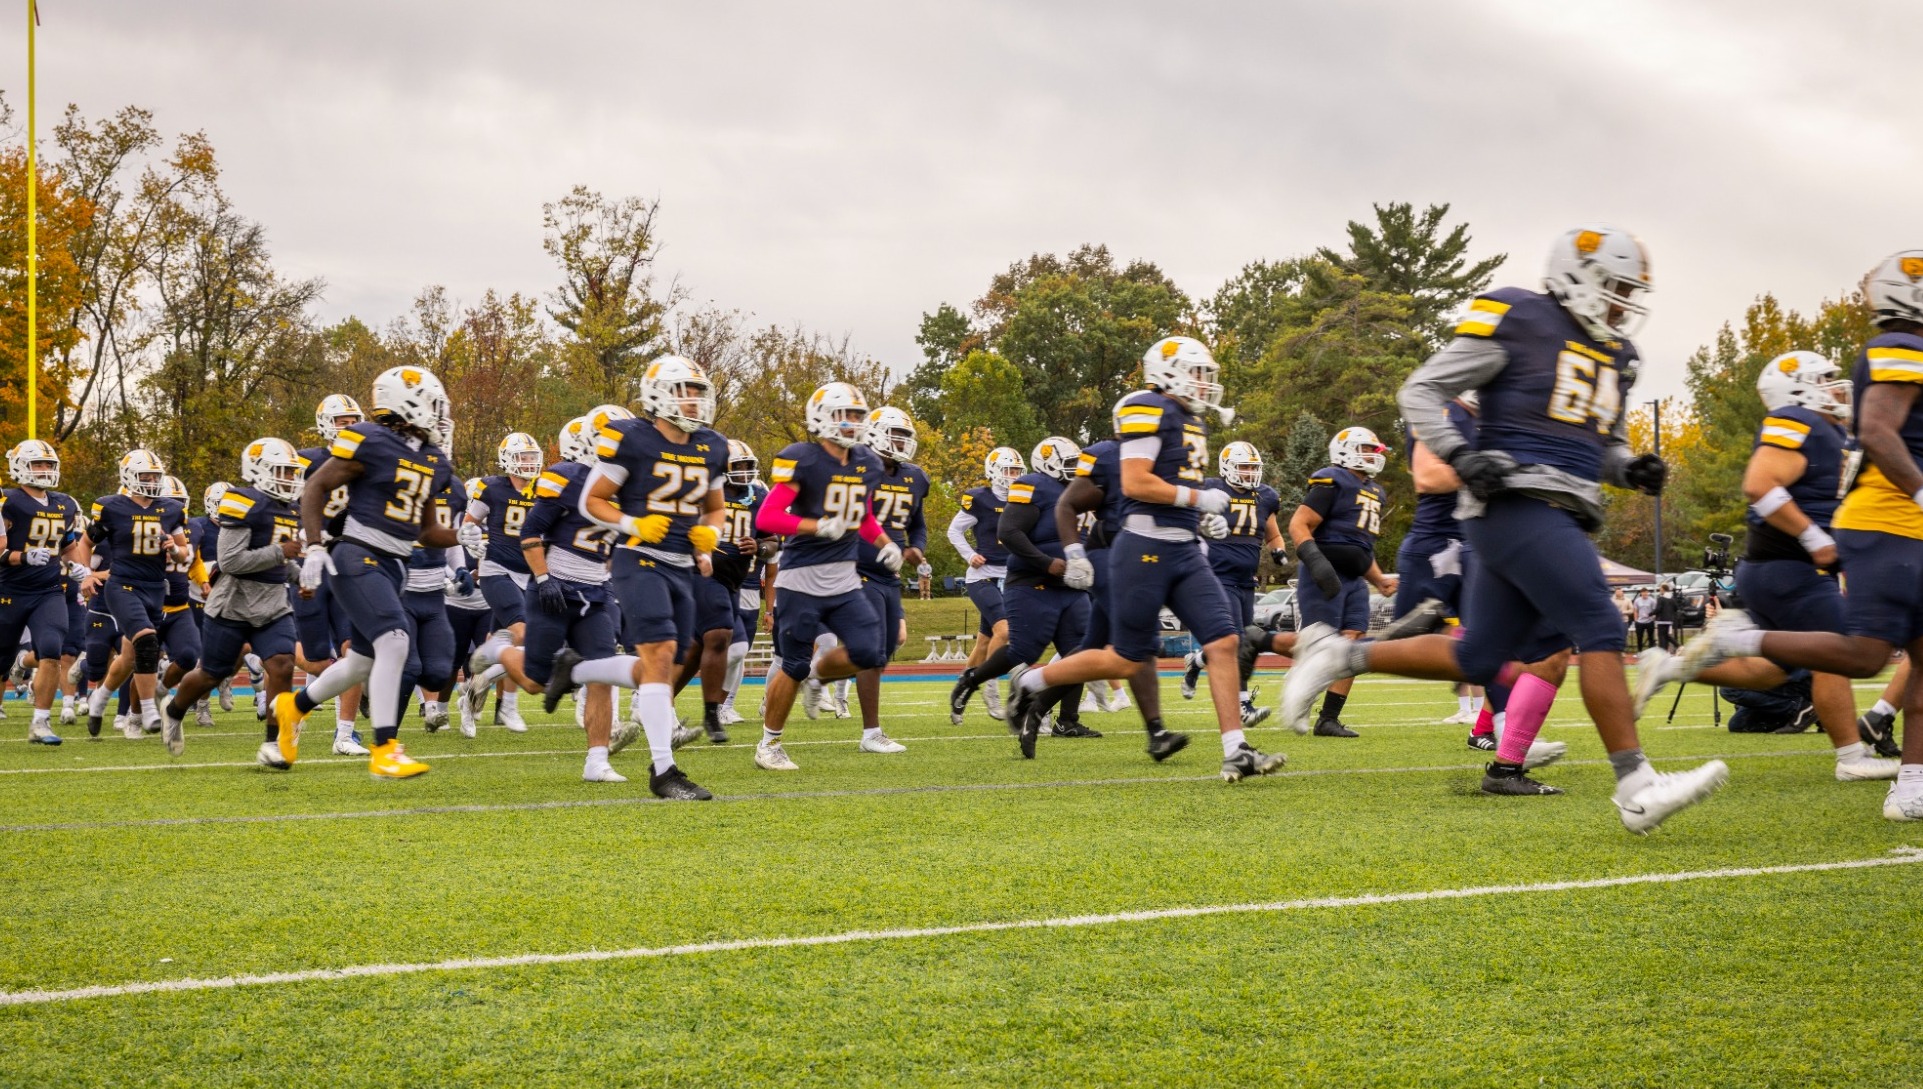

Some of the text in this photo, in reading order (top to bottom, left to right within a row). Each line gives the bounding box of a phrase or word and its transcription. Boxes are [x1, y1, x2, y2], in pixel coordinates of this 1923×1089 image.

[1548, 350, 1621, 434] 64
[384, 467, 433, 525] 31
[646, 461, 709, 515] 22
[824, 482, 867, 530] 96
[504, 505, 526, 537] 8
[873, 489, 913, 530] 75
[1230, 504, 1258, 536] 71
[24, 517, 66, 556] 95
[131, 521, 163, 555] 18
